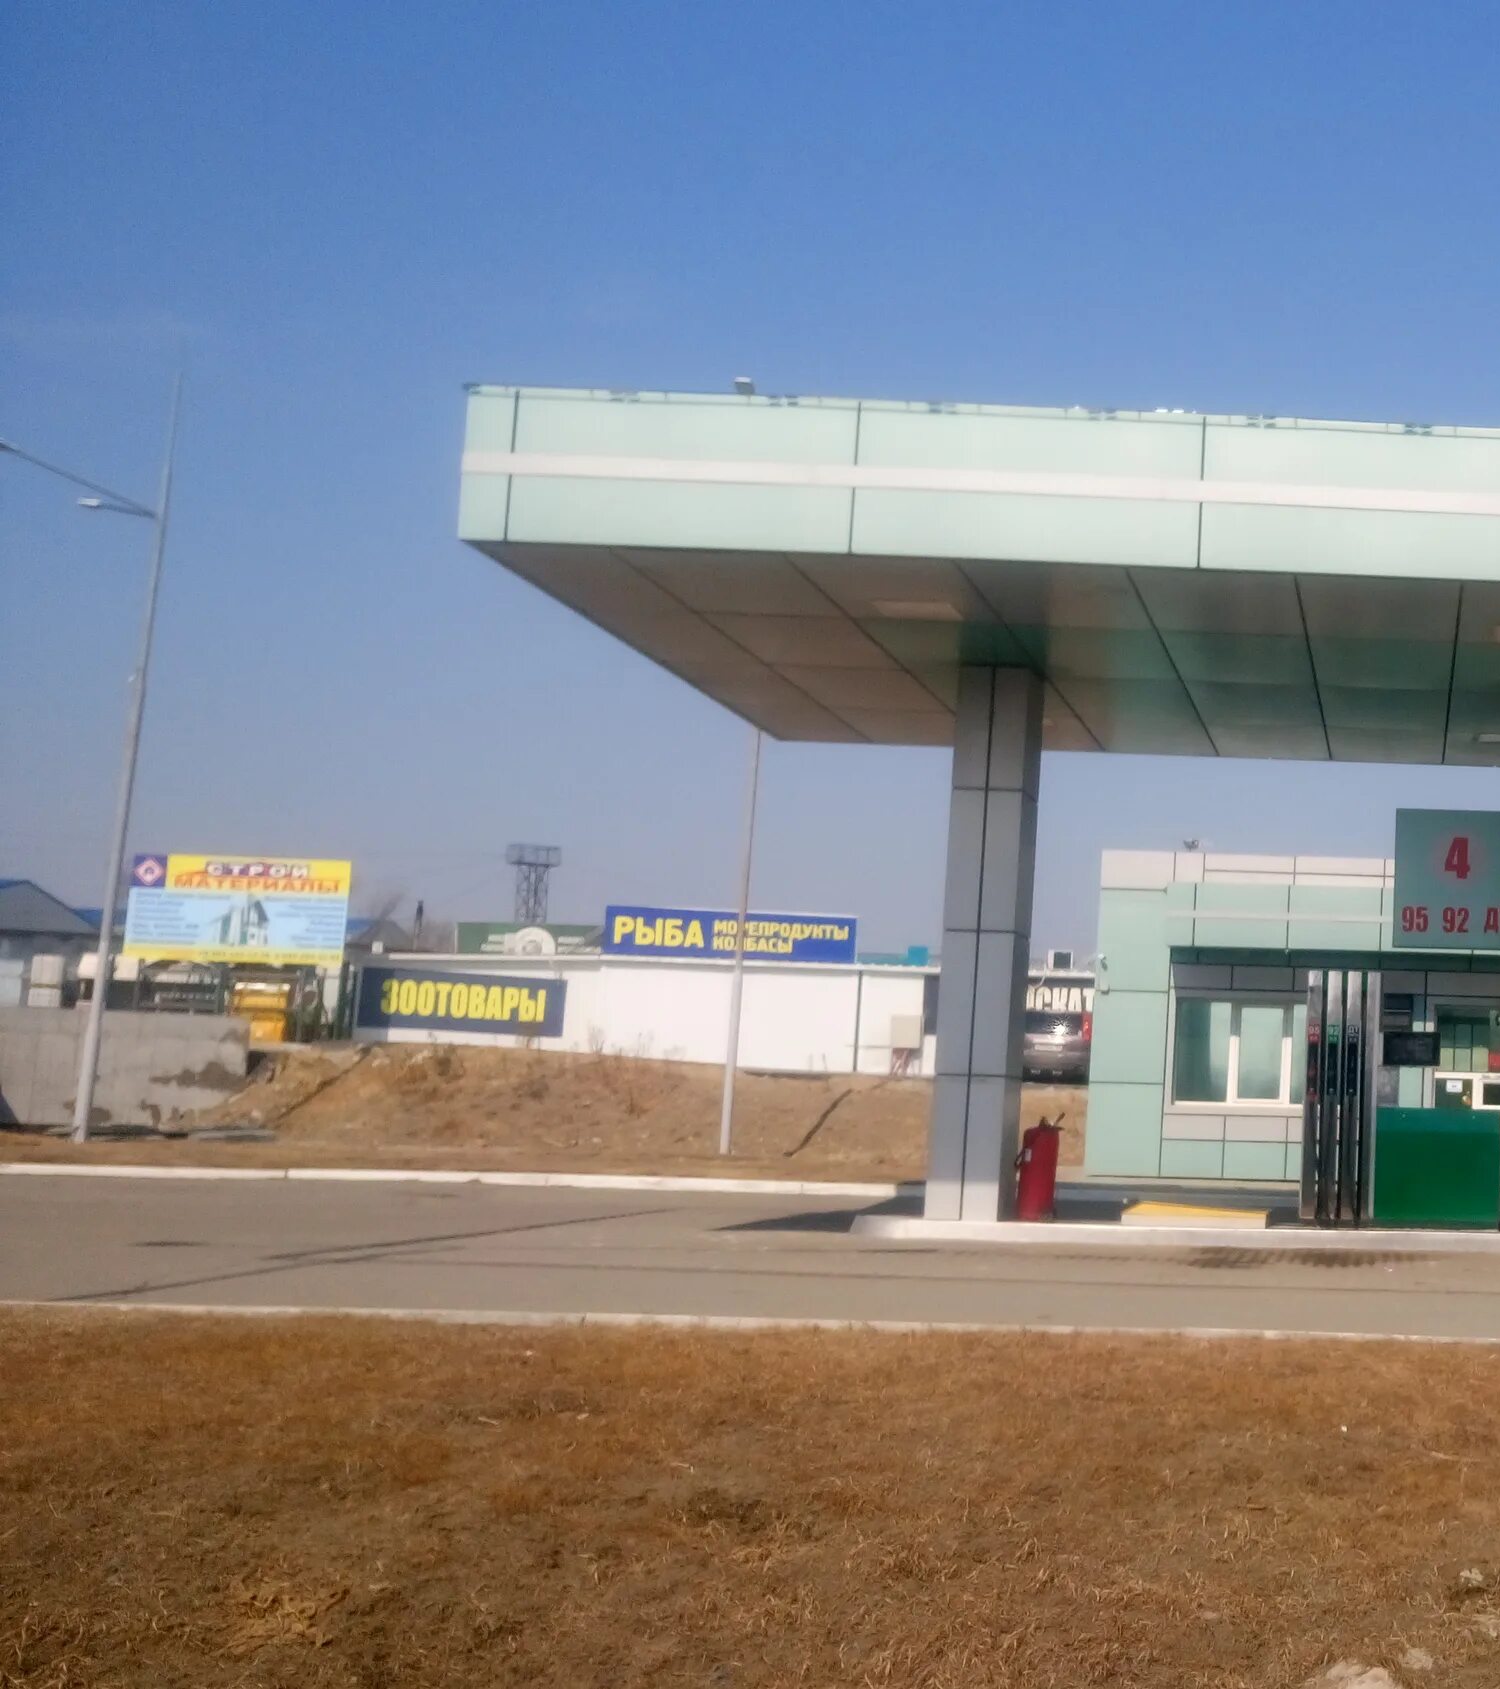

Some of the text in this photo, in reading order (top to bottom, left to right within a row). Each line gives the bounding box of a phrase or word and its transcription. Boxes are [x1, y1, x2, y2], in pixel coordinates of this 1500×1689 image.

[1444, 836, 1471, 880] 4
[173, 870, 341, 894] МАТЕРИАЛЫ
[613, 915, 705, 948] РЫБА
[713, 919, 850, 941] МОЕПРОДУКТЫ
[1402, 906, 1470, 933] 95 92
[381, 978, 546, 1023] ЗООТОВАРЫ
